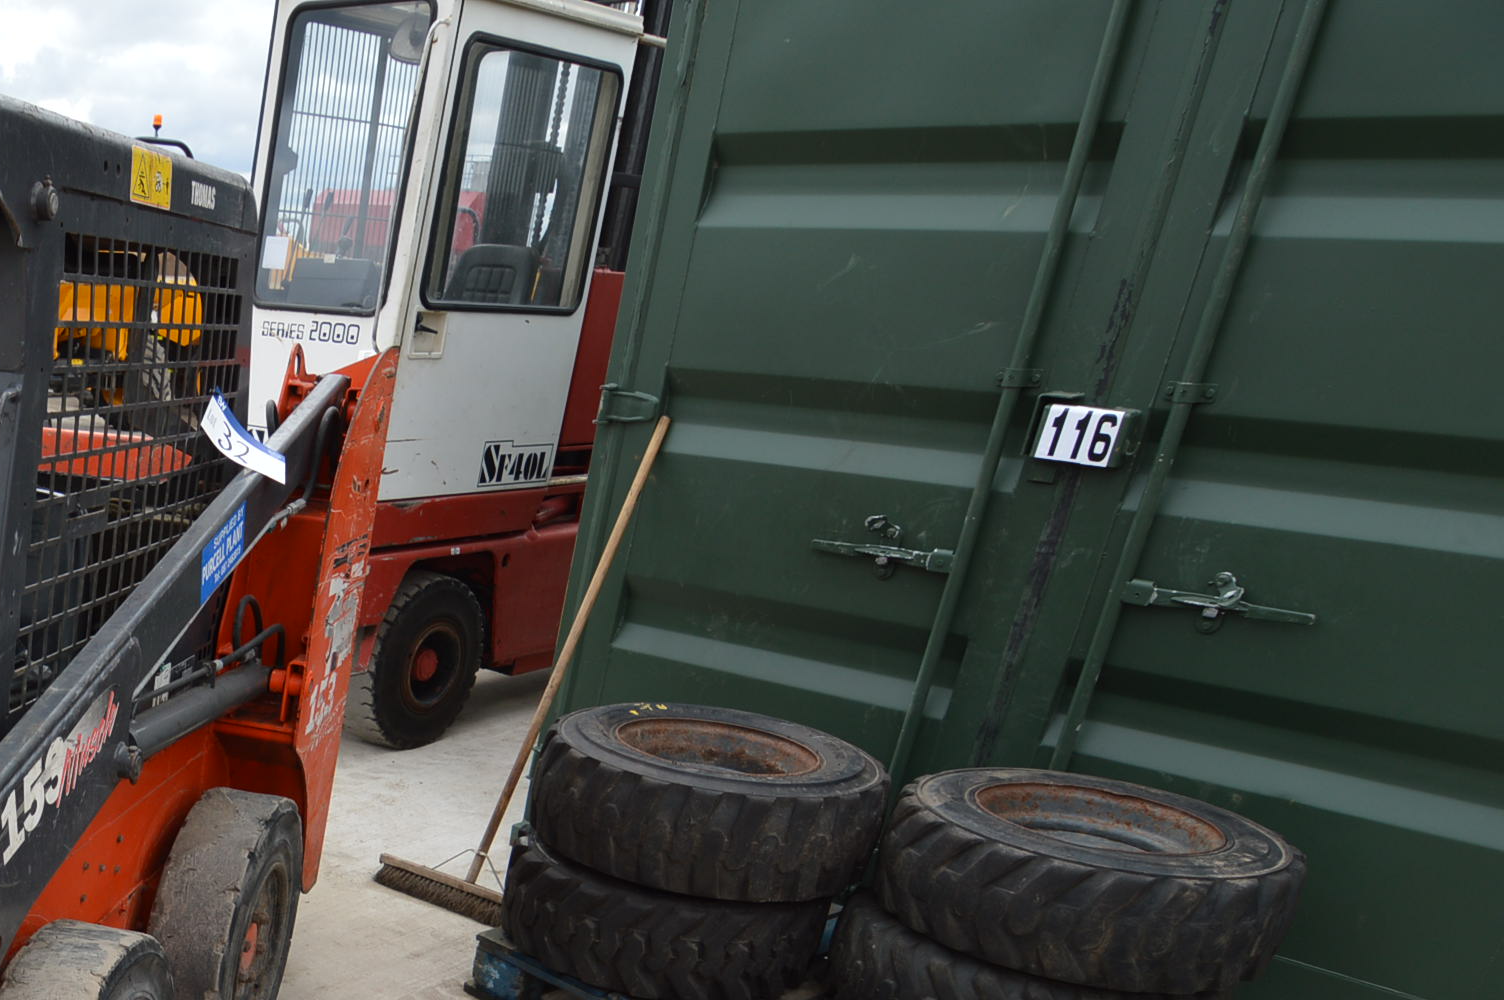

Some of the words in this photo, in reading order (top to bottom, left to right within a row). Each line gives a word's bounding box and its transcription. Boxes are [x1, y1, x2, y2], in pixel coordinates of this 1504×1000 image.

[191, 181, 216, 211] THOMAS
[261, 320, 305, 340] SERIES
[309, 320, 361, 345] 2000
[217, 421, 250, 464] 32
[1047, 407, 1118, 462] 116
[226, 521, 244, 557] PLANT
